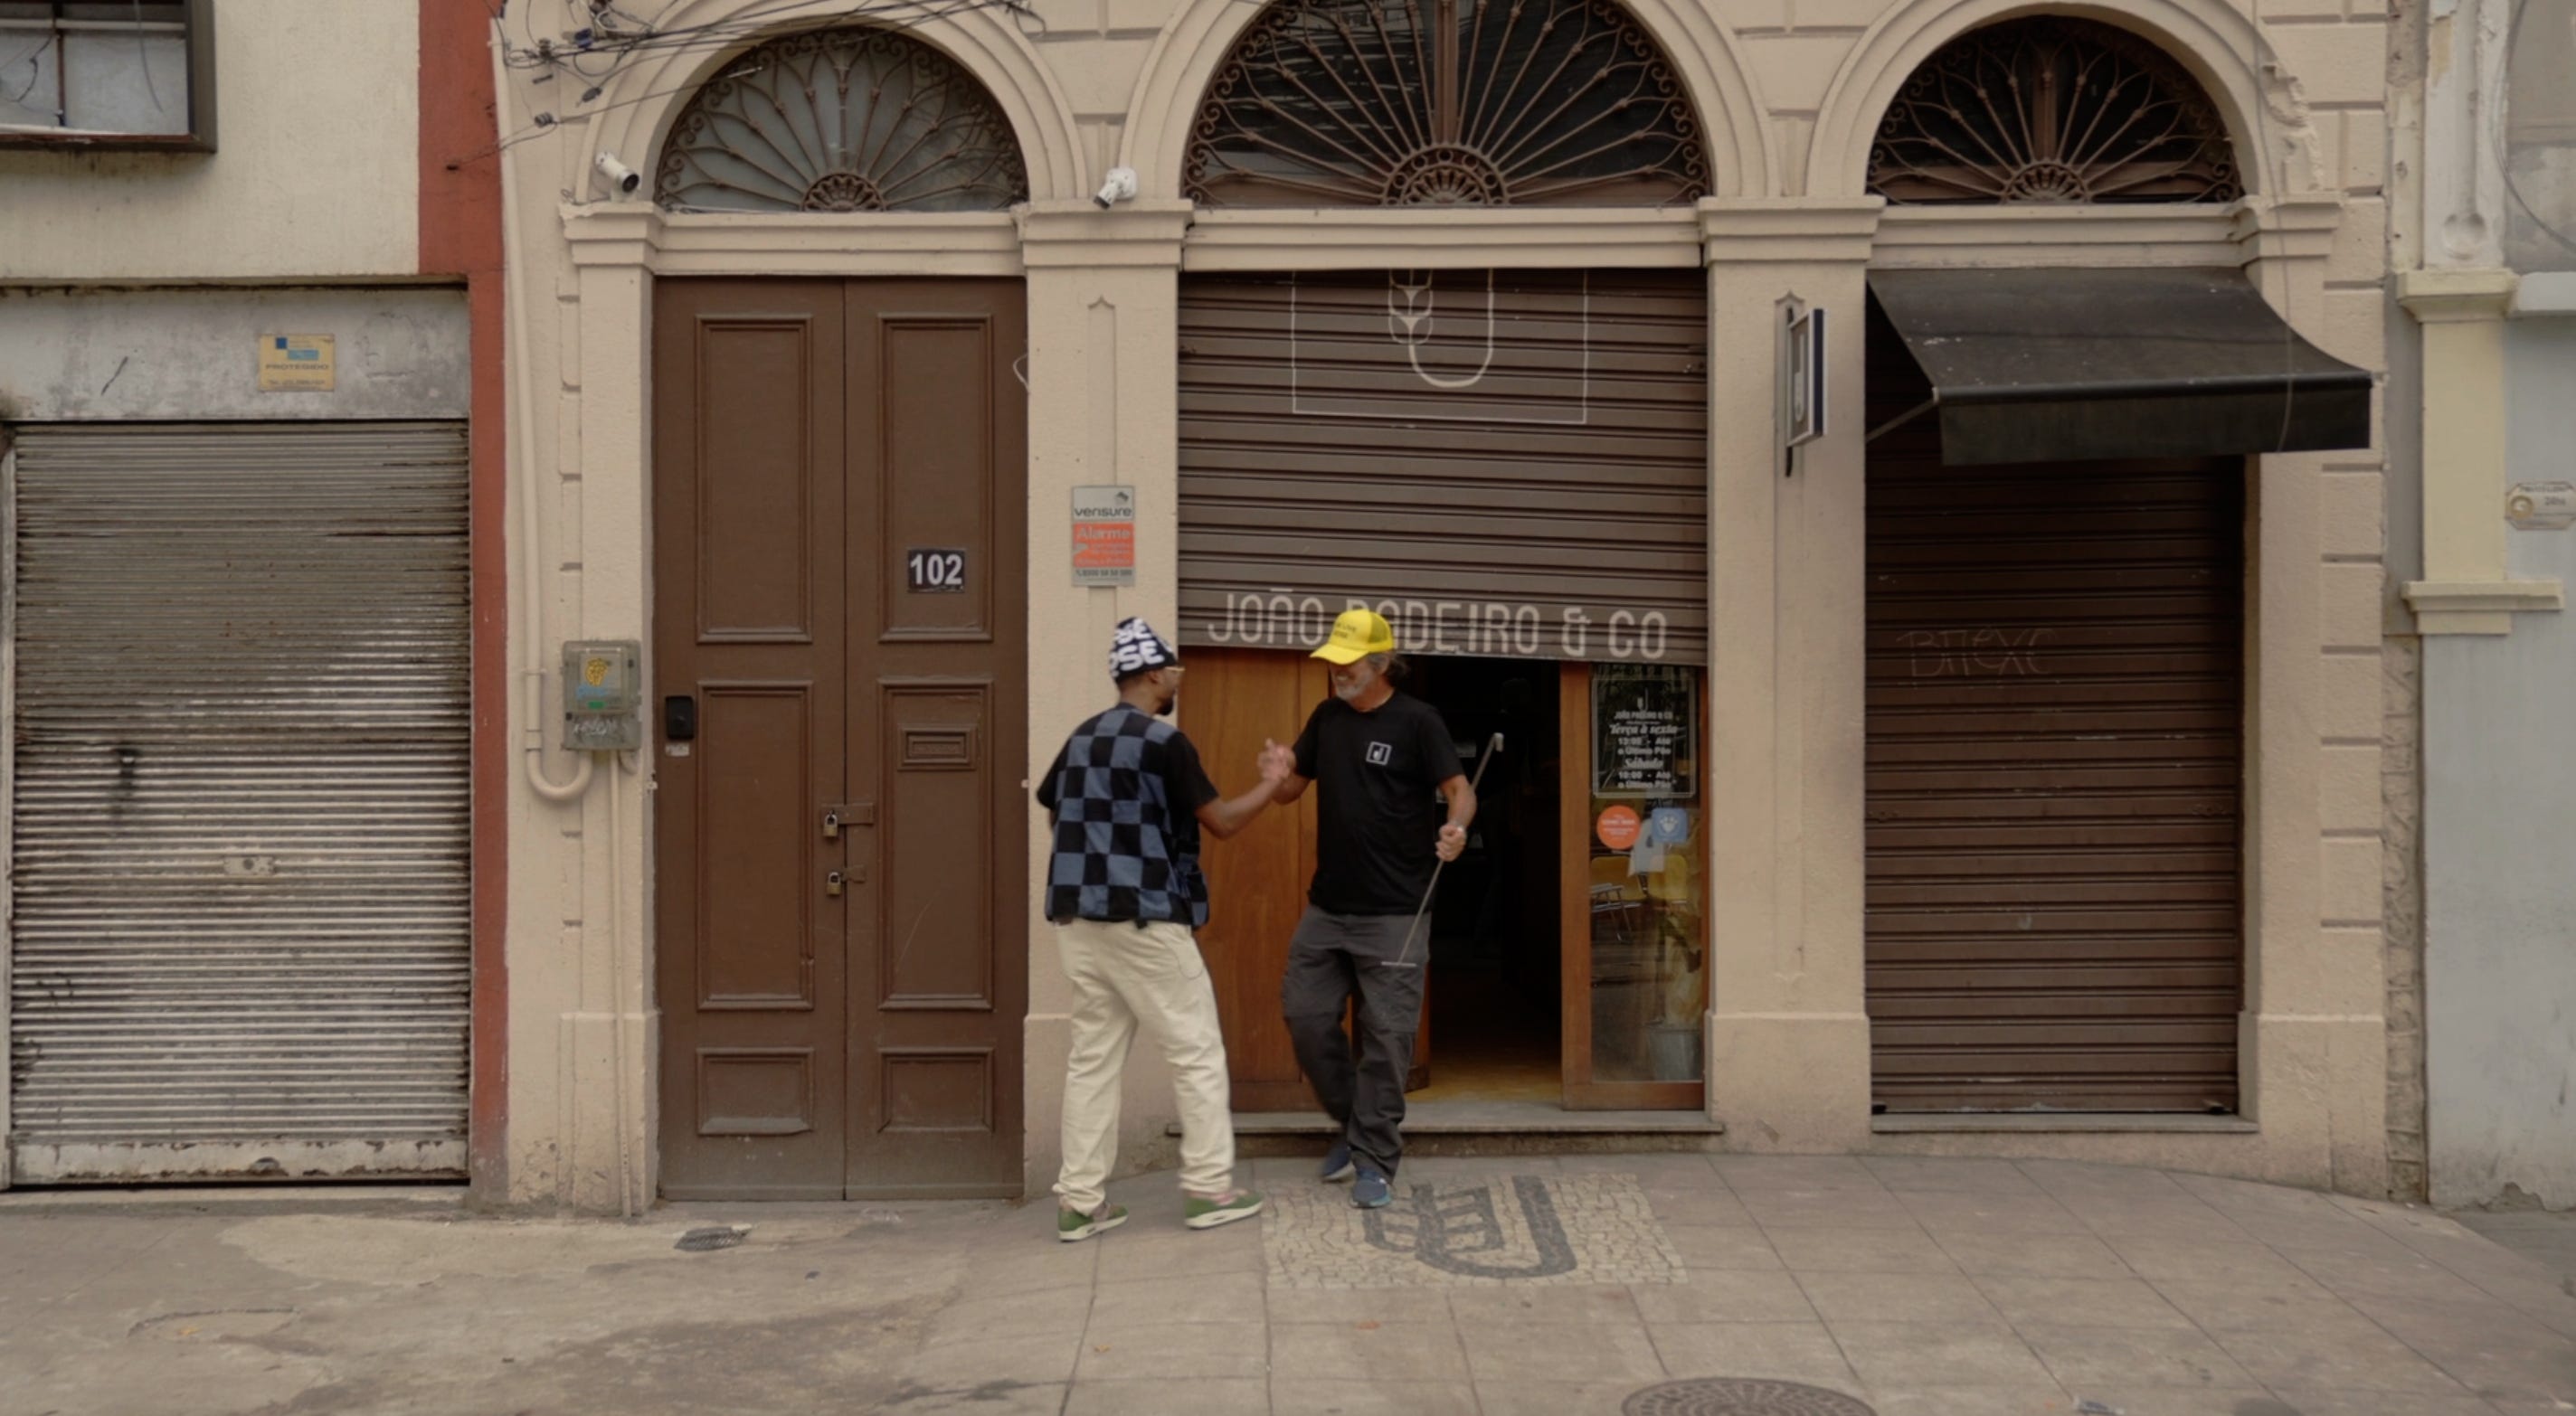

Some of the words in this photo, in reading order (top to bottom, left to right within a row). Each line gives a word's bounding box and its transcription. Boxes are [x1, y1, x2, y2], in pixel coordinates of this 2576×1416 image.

[910, 553, 962, 585] 102
[1208, 588, 1323, 646] JOÃO
[1345, 599, 1539, 655] ADEIRO
[1561, 607, 1592, 656] &
[1608, 609, 1666, 659] CO
